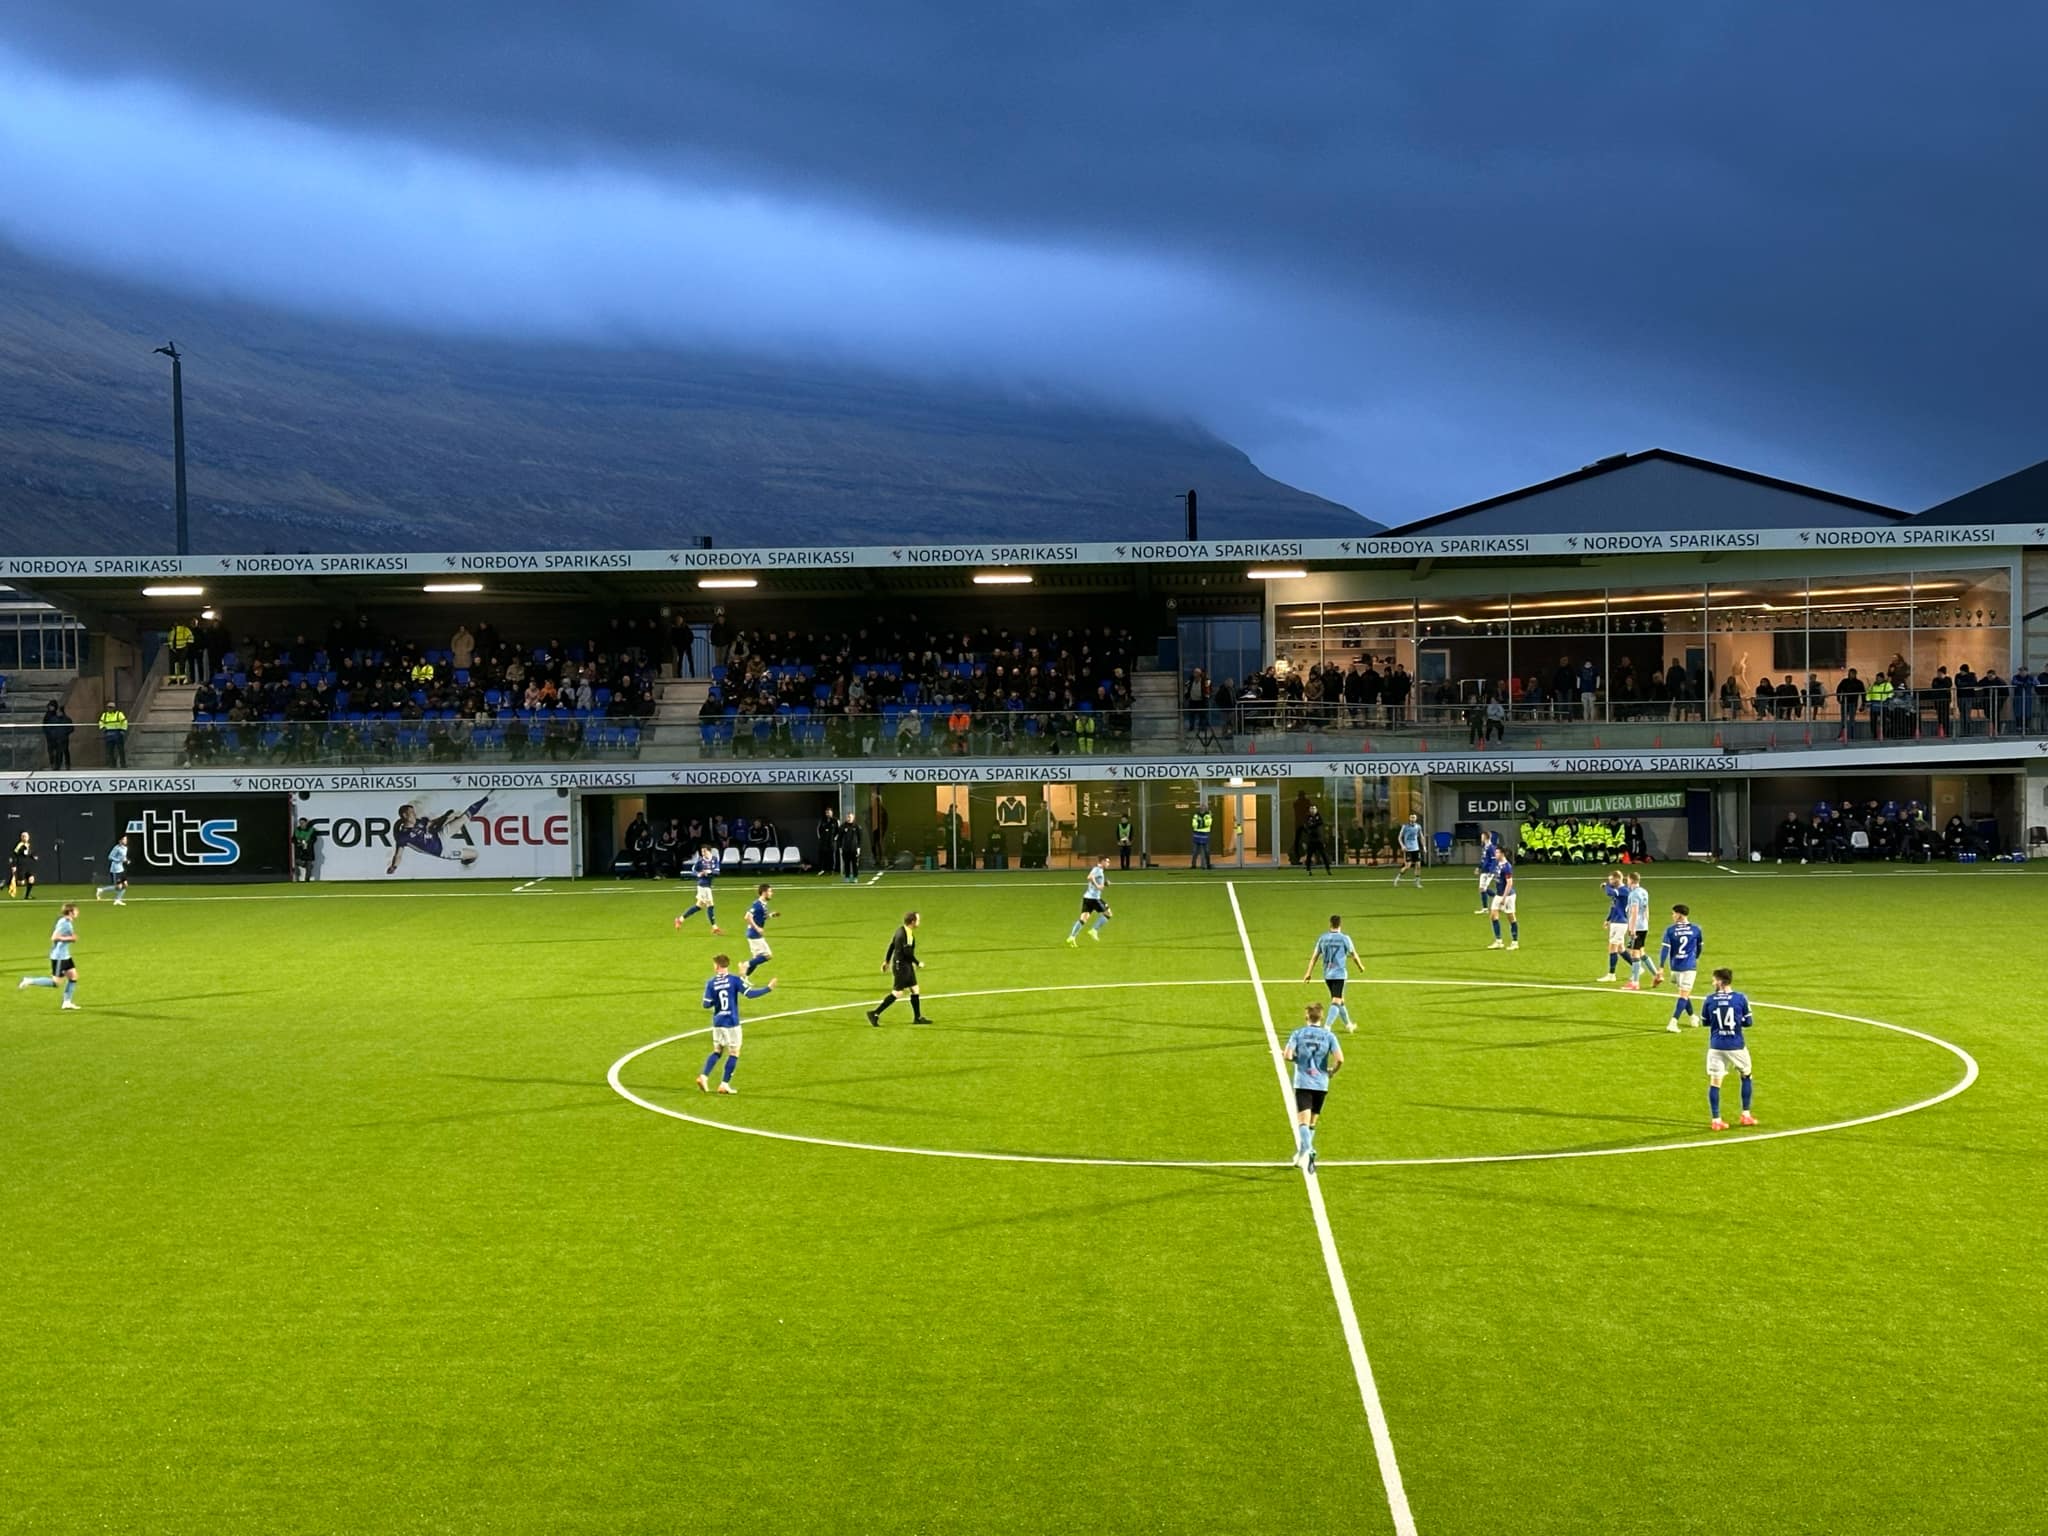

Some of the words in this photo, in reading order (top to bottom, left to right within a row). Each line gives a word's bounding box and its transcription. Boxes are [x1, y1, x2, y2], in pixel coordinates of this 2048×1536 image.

[1669, 533, 1760, 548] SPARIKASSI
[1903, 528, 1995, 544] SPARIKASSI
[1215, 543, 1303, 557] SPARIKASSI
[1440, 538, 1529, 553] SPARIKASSI
[544, 554, 631, 568] SPARIKASSI
[768, 551, 854, 565] SPARIKASSI
[991, 547, 1078, 561] SPARIKASSI
[94, 559, 183, 573] SPARIKASSI
[320, 557, 408, 571] SPARIKASSI
[1206, 762, 1292, 777] SPARIKASSI
[1426, 760, 1514, 773] SPARIKASSI
[1650, 757, 1738, 770] SPARIKASSI
[550, 773, 636, 787] SPARIKASSI
[768, 769, 853, 783] SPARIKASSI
[986, 767, 1071, 780] SPARIKASSI
[108, 778, 196, 792] SPARIKASSI
[331, 776, 417, 789] SPARIKASSI
[1552, 800, 1569, 814] VIT
[1572, 797, 1602, 812] VILJA
[1605, 797, 1632, 810] VERA
[142, 809, 240, 866] tts
[1679, 936, 1688, 954] 2
[718, 989, 729, 1010] 6
[1713, 1007, 1736, 1030] 14
